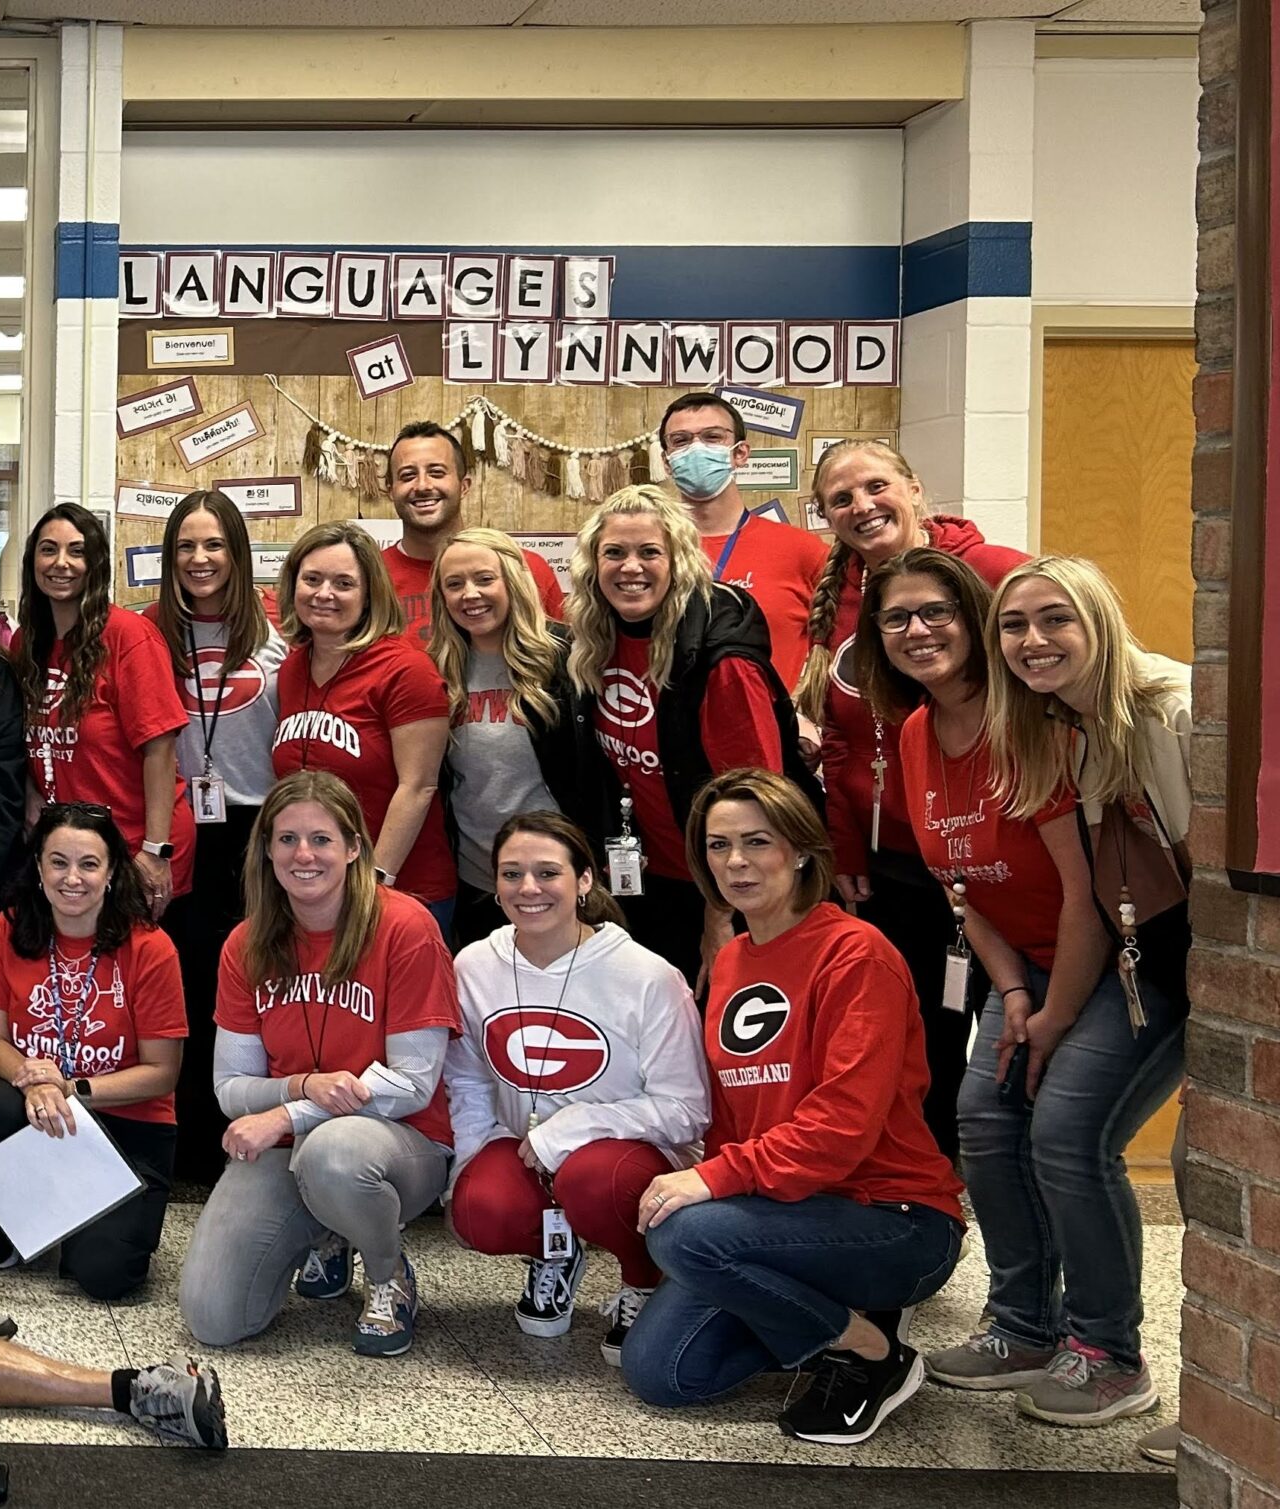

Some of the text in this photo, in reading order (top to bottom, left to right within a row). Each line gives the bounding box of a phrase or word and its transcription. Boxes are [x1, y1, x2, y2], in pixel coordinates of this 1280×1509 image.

[124, 261, 596, 309] LANGUAGES
[165, 339, 215, 349] Bienvenue!
[462, 329, 886, 374] LYNNWOOD
[368, 354, 397, 380] at
[718, 1063, 791, 1087] GUILDERLAND
